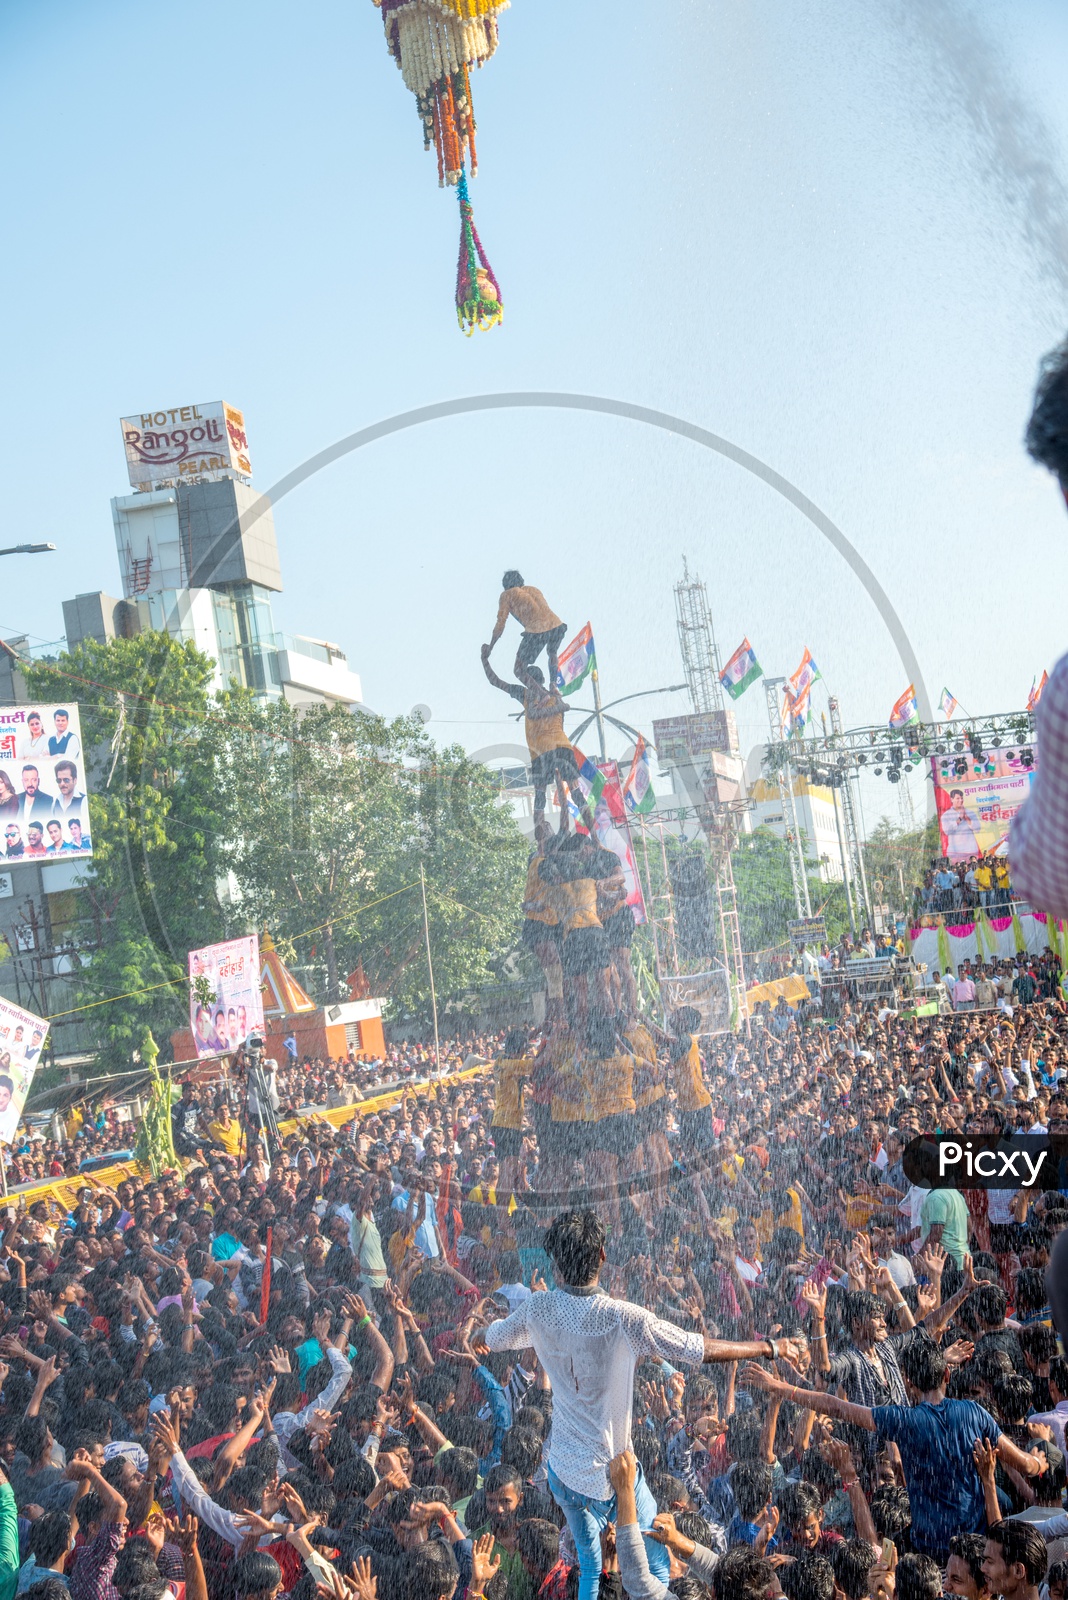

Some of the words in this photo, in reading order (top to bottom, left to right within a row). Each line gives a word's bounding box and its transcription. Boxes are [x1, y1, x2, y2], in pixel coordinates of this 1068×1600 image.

[140, 405, 203, 428] HOTEL
[125, 419, 223, 464] Rangoli
[179, 457, 229, 475] PEARL
[964, 787, 977, 796] युवा
[978, 783, 1008, 792] स्वाभिमान
[1010, 779, 1024, 788] पार्टी
